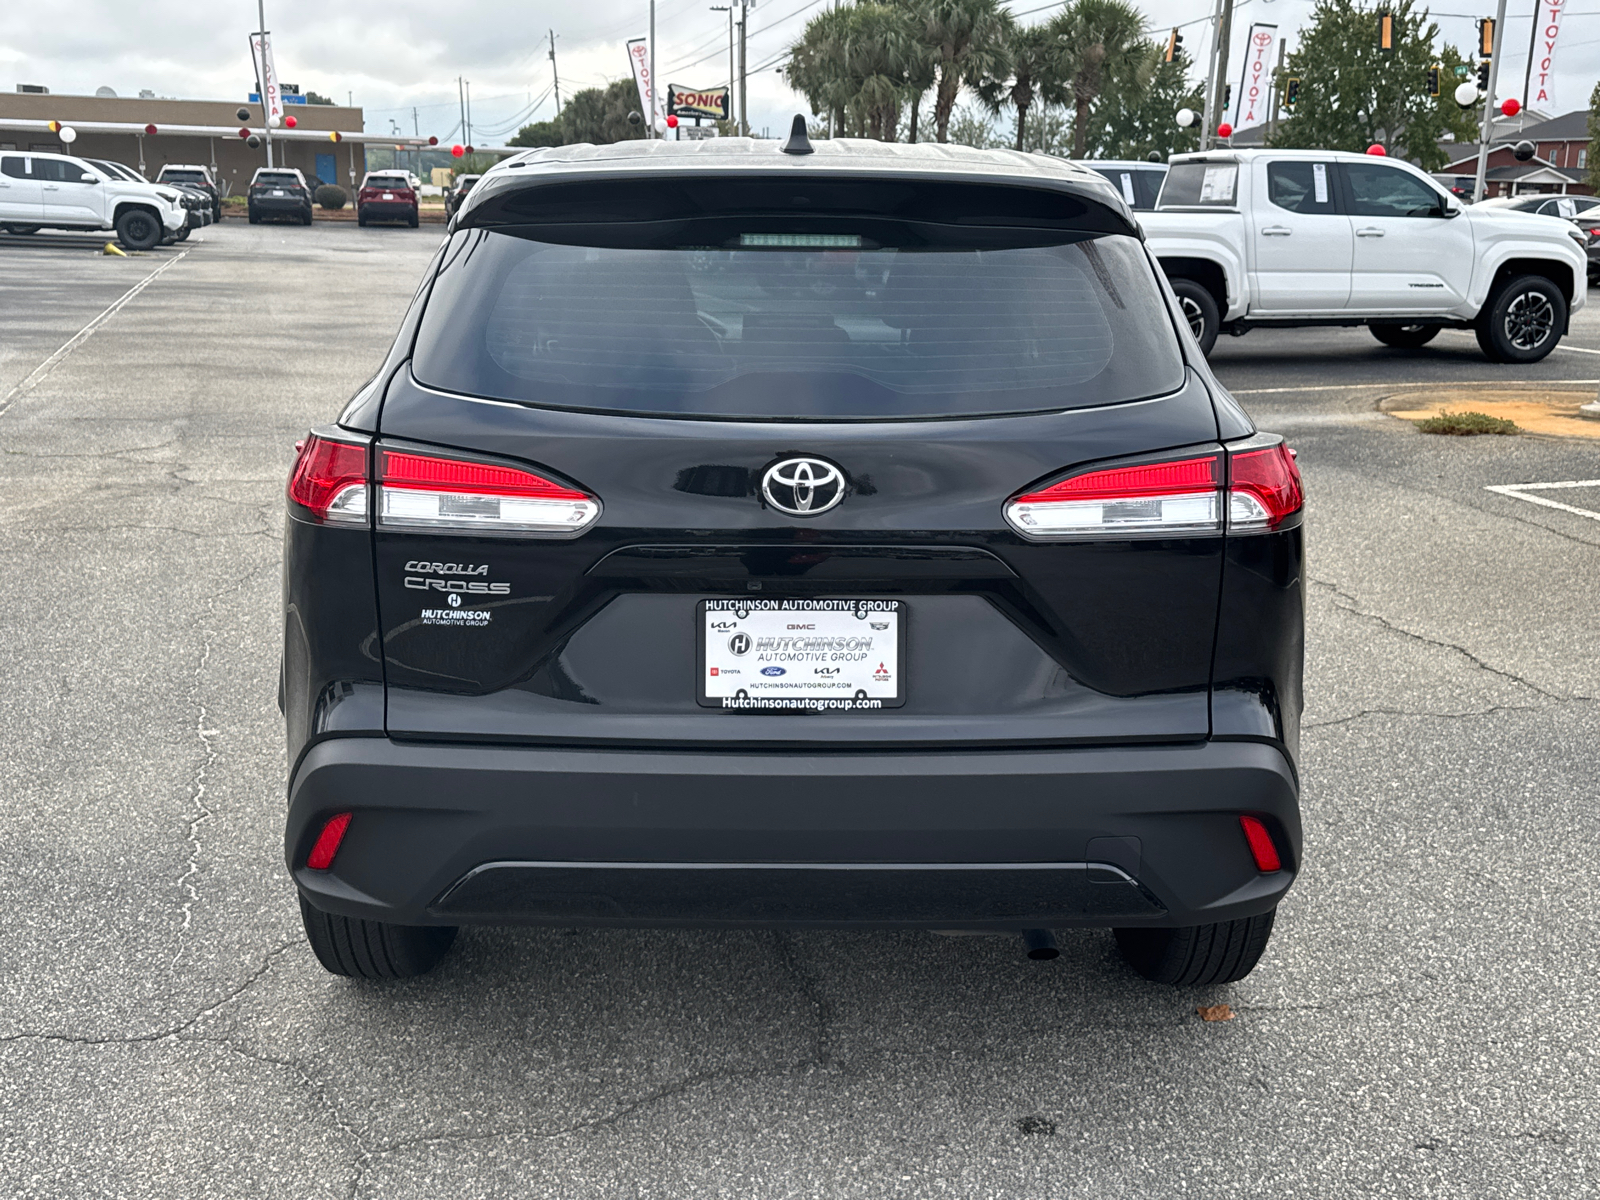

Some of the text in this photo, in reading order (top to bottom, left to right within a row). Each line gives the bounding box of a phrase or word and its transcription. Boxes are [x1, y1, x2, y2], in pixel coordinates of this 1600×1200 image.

[1537, 9, 1561, 101] TOYOTA
[265, 63, 279, 115] YOTA
[638, 58, 659, 116] TOYO
[1245, 49, 1264, 121] TOYOTA
[675, 92, 723, 108] SONIC
[404, 560, 489, 575] COROLLA
[404, 576, 511, 595] CROSS
[705, 600, 899, 611] HUTCHINSON AUTOMOTIVE GROUP
[421, 609, 491, 621] HUTCHINSON
[755, 637, 873, 651] HUTCHINSON
[757, 652, 868, 661] AUTOMOTIVE GROUP
[764, 666, 782, 676] Ford
[722, 697, 882, 710] Hutchinsonautogroup.com
